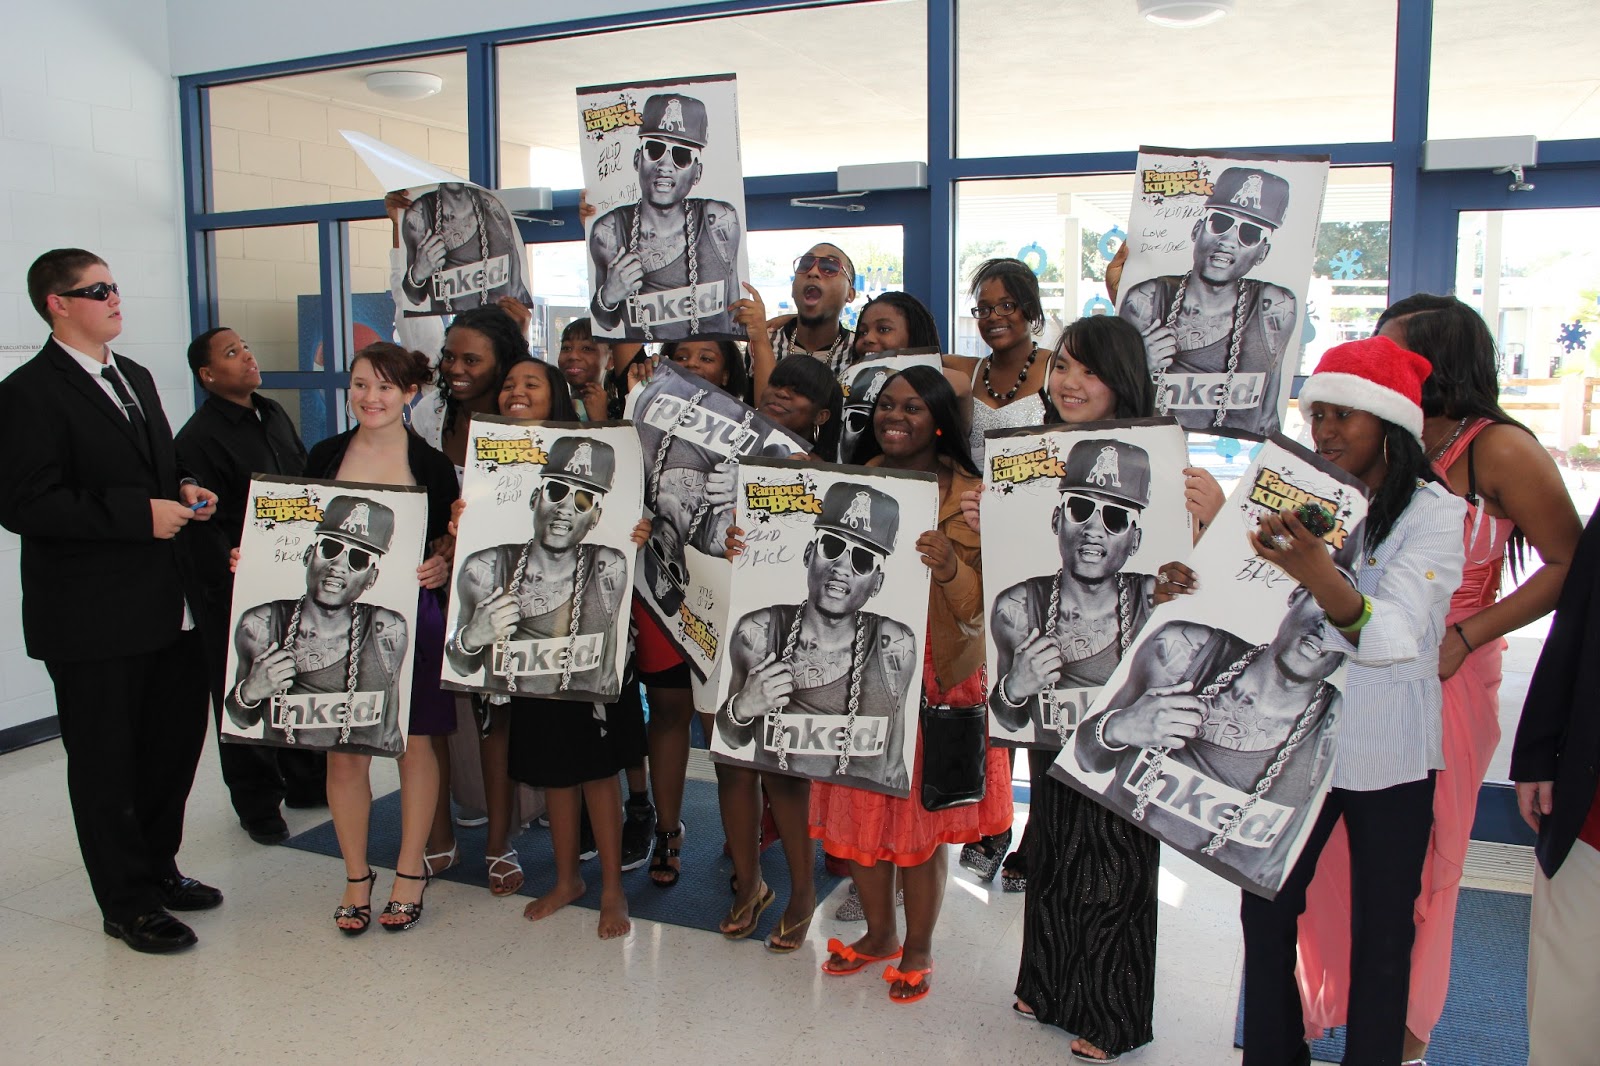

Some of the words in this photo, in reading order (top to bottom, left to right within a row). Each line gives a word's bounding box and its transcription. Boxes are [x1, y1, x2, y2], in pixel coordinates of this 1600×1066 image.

[584, 102, 628, 121] Famous
[1143, 170, 1199, 183] Famous
[476, 436, 532, 449] Famous
[992, 449, 1047, 470] Famous
[746, 483, 805, 498] Famous
[256, 497, 309, 509] Famous
